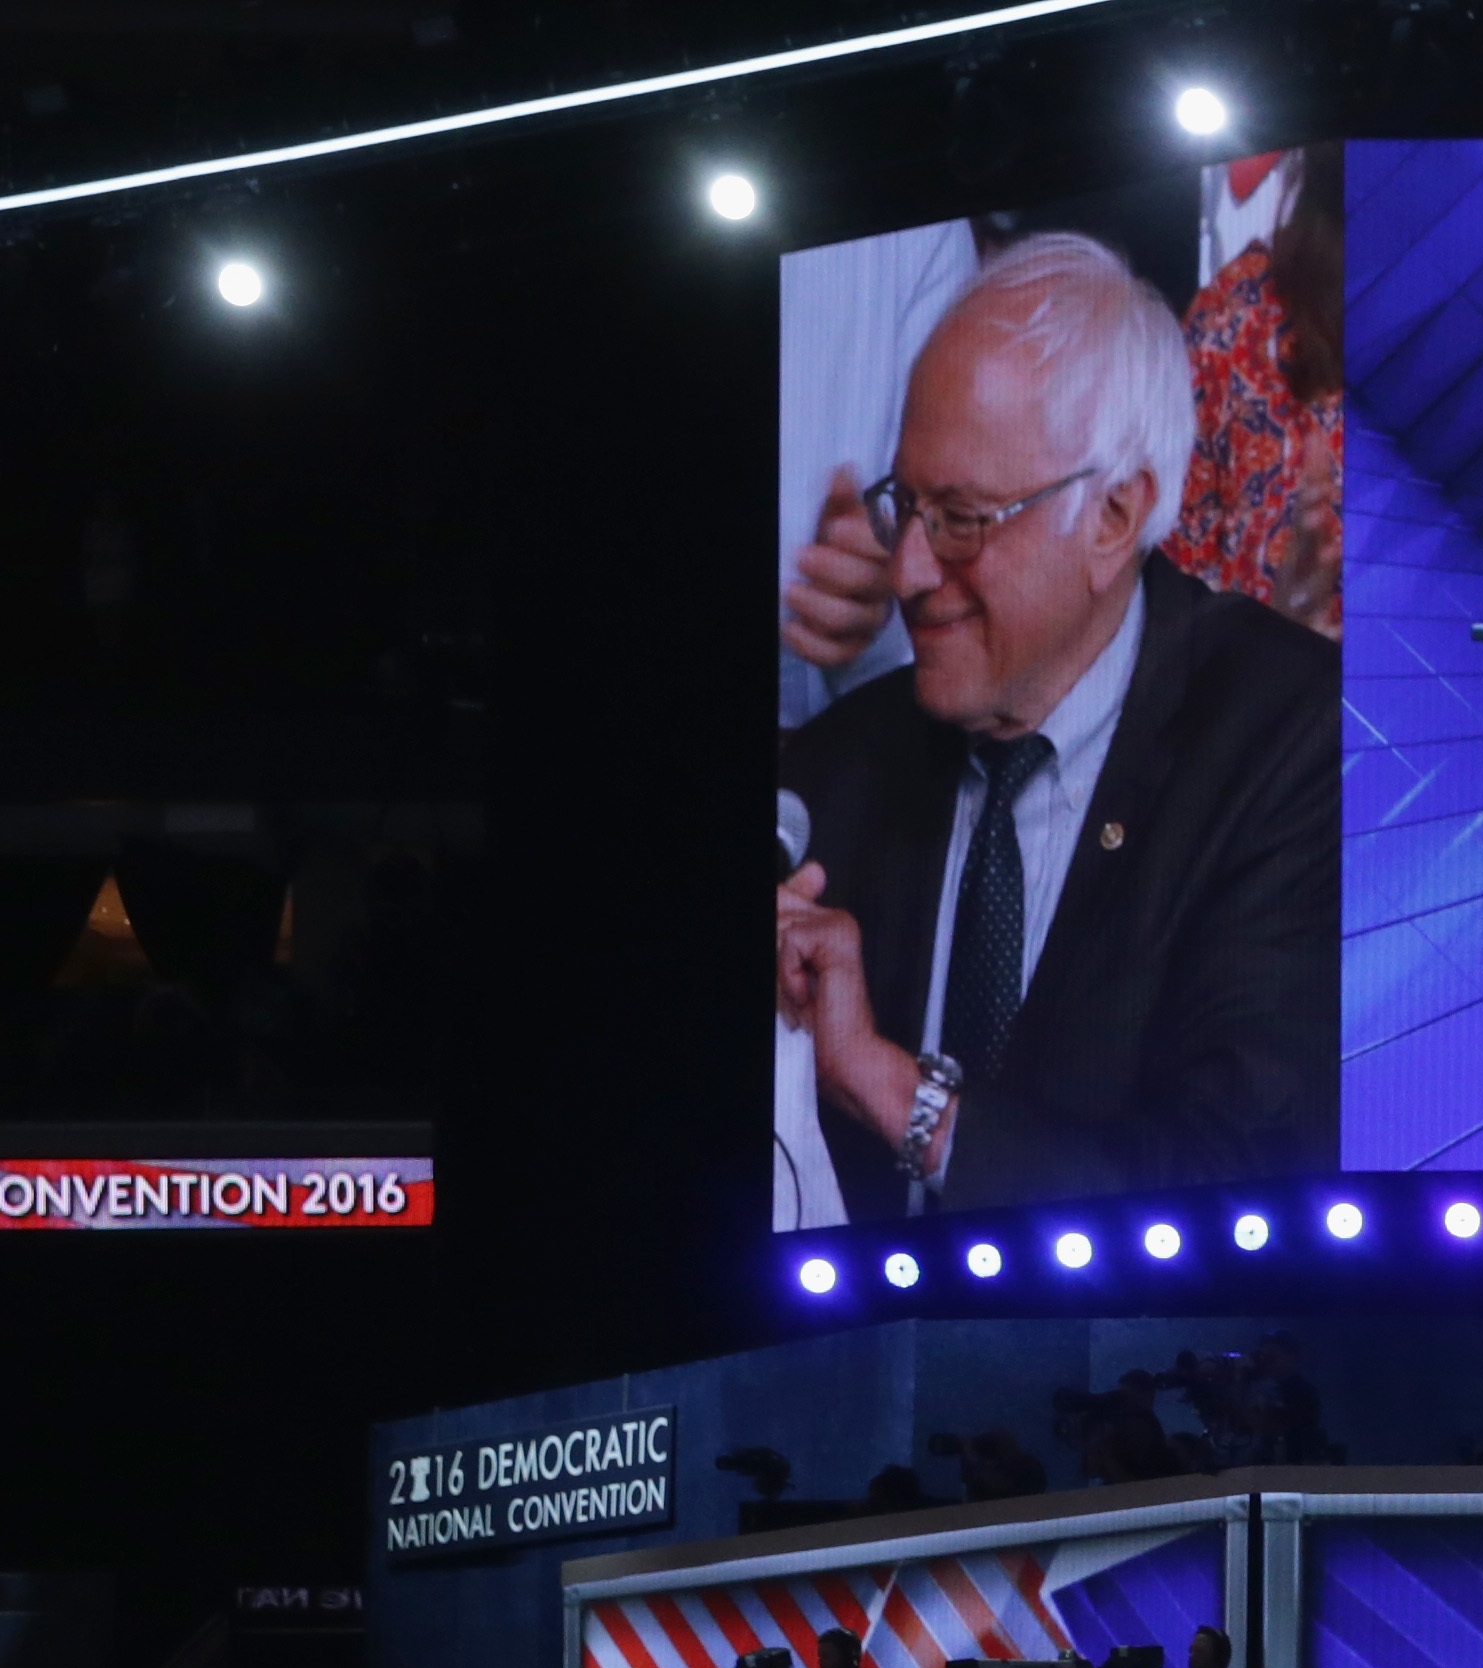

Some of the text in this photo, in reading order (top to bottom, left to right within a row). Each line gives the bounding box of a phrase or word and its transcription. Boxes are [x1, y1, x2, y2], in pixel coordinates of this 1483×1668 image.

[302, 1172, 406, 1214] 2016
[477, 1416, 669, 1491] DEMOCRATIC
[387, 1476, 667, 1551] NATIONAL CONVENTION
